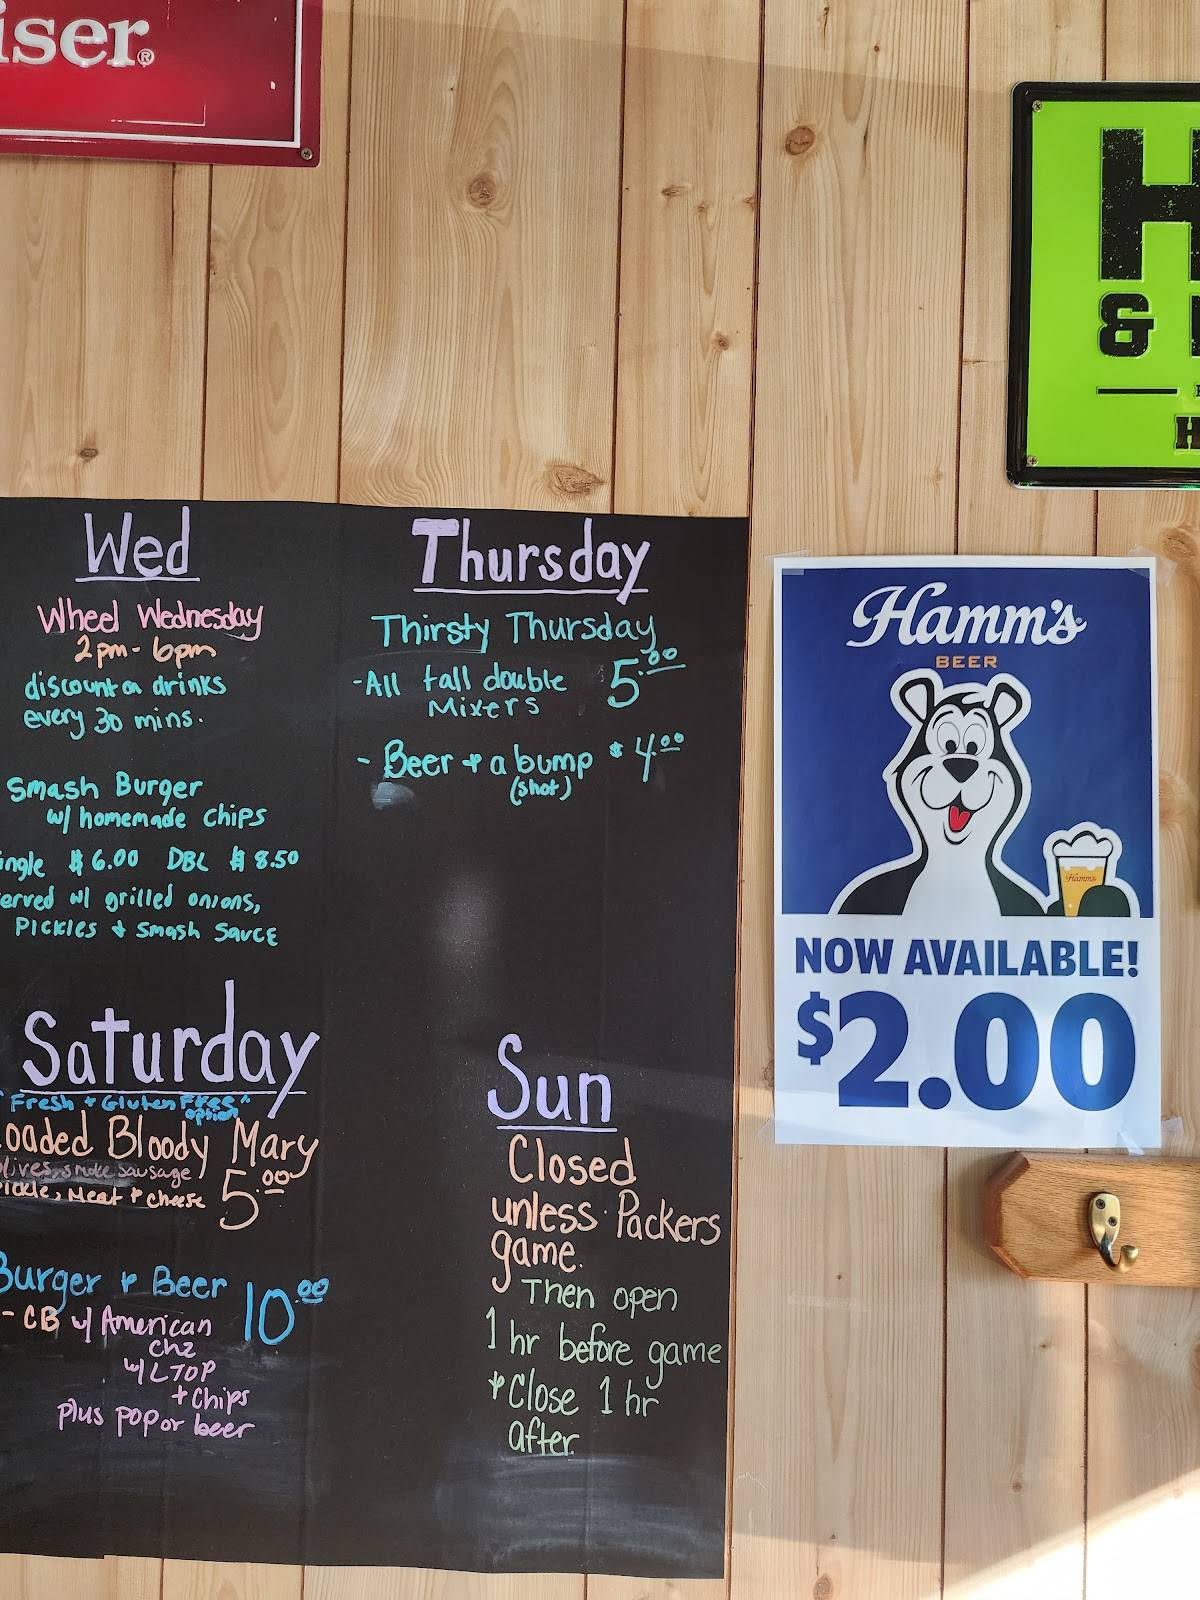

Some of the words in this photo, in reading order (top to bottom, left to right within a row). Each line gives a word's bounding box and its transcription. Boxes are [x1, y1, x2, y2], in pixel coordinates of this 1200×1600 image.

[1099, 293, 1154, 358] &
[84, 505, 190, 577] Wed
[412, 517, 651, 606] Thursday
[37, 597, 120, 633] Wheel
[136, 598, 264, 641] Wednesday
[371, 613, 490, 654] Thirsty
[505, 611, 657, 655] Thursday
[846, 581, 1087, 648] Hamm's
[152, 636, 217, 668] 6pm
[935, 655, 998, 669] BEER
[24, 671, 118, 700] discount
[152, 672, 228, 697] drinks
[423, 664, 471, 692] tall
[482, 662, 568, 693] double
[23, 707, 84, 740] every
[94, 707, 123, 734] 30
[428, 696, 540, 719] Mixers
[383, 738, 454, 780] Beer
[489, 755, 507, 776] a
[513, 743, 594, 780] bump
[115, 771, 203, 806] Burger
[509, 775, 572, 806] (shot)
[79, 806, 186, 830] homemade
[167, 847, 209, 872] DBL
[0, 885, 54, 911] erved
[105, 883, 174, 912] grilled
[795, 937, 893, 975] NOW
[904, 938, 1140, 978] AVAILABLE!
[22, 979, 320, 1120] Saturday
[797, 990, 1136, 1112] $2.00
[487, 1033, 612, 1125] Sun
[101, 1094, 177, 1112] Gluten
[0, 1110, 94, 1157] oaded
[108, 1114, 209, 1180] Bloody
[232, 1117, 320, 1178] Mary
[508, 1133, 637, 1186] Closed
[68, 1186, 124, 1206] Meat
[117, 1165, 192, 1189] sausage
[491, 1190, 599, 1234] unless
[616, 1188, 721, 1246] Packers
[0, 1251, 101, 1315] Burger
[152, 1265, 228, 1300] Beer
[520, 1278, 595, 1310] Then
[613, 1286, 678, 1320] open
[24, 1304, 60, 1332] CB
[101, 1304, 213, 1338] American
[485, 1305, 497, 1350] 1
[509, 1318, 540, 1356] hr
[558, 1321, 634, 1366] before
[645, 1340, 722, 1390] game
[599, 1375, 613, 1415] 1
[625, 1378, 660, 1417] hr
[56, 1398, 105, 1431] plus
[115, 1405, 160, 1437] pop
[160, 1417, 186, 1433] or
[193, 1413, 255, 1439] beer
